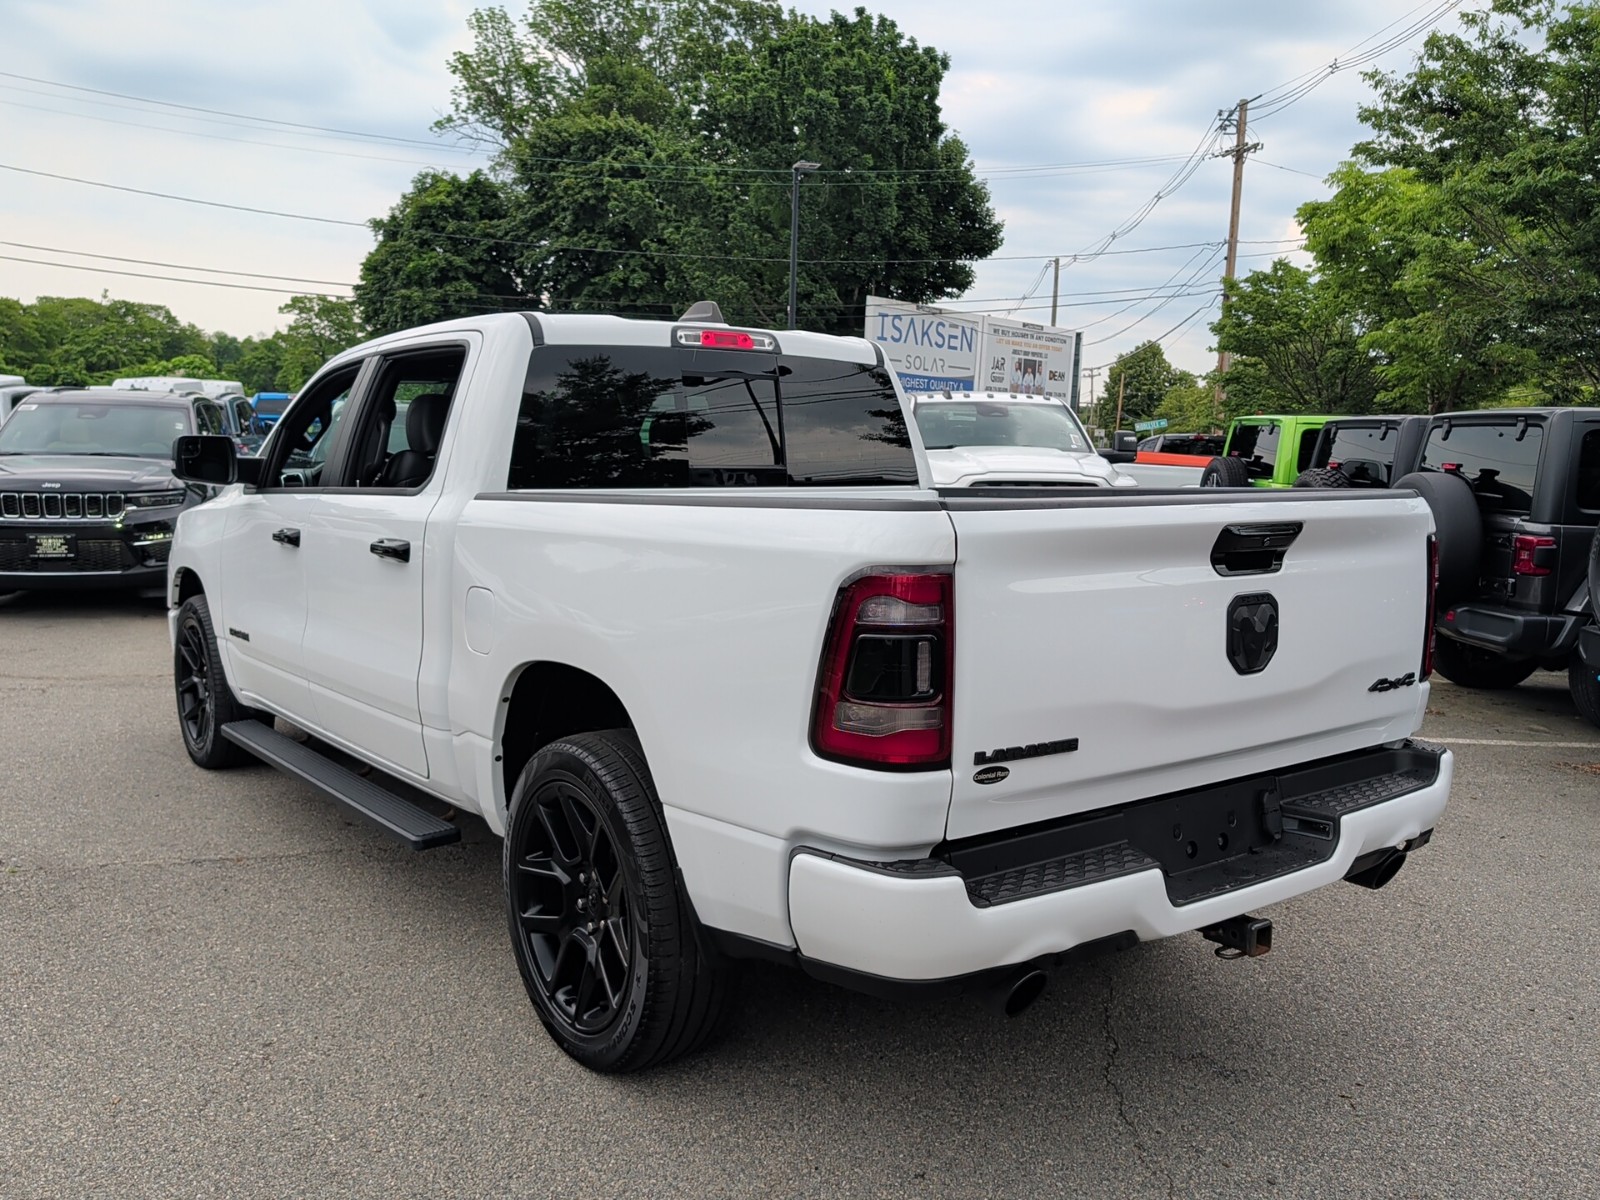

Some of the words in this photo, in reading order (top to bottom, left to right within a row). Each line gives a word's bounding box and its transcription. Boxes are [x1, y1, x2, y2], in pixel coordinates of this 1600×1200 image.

[877, 312, 974, 352] ISAKSEN
[1001, 329, 1010, 337] BUY
[1011, 331, 1029, 339] HOUSES
[1045, 336, 1067, 345] CONDITION
[905, 354, 945, 373] SOLAR
[991, 356, 1006, 371] JAR
[1048, 369, 1066, 382] DEAN
[930, 379, 959, 391] QUALITY
[41, 481, 61, 489] Jeep
[974, 737, 1079, 765] LARAMIE
[974, 771, 996, 781] Colonial
[996, 770, 1010, 778] Ram
